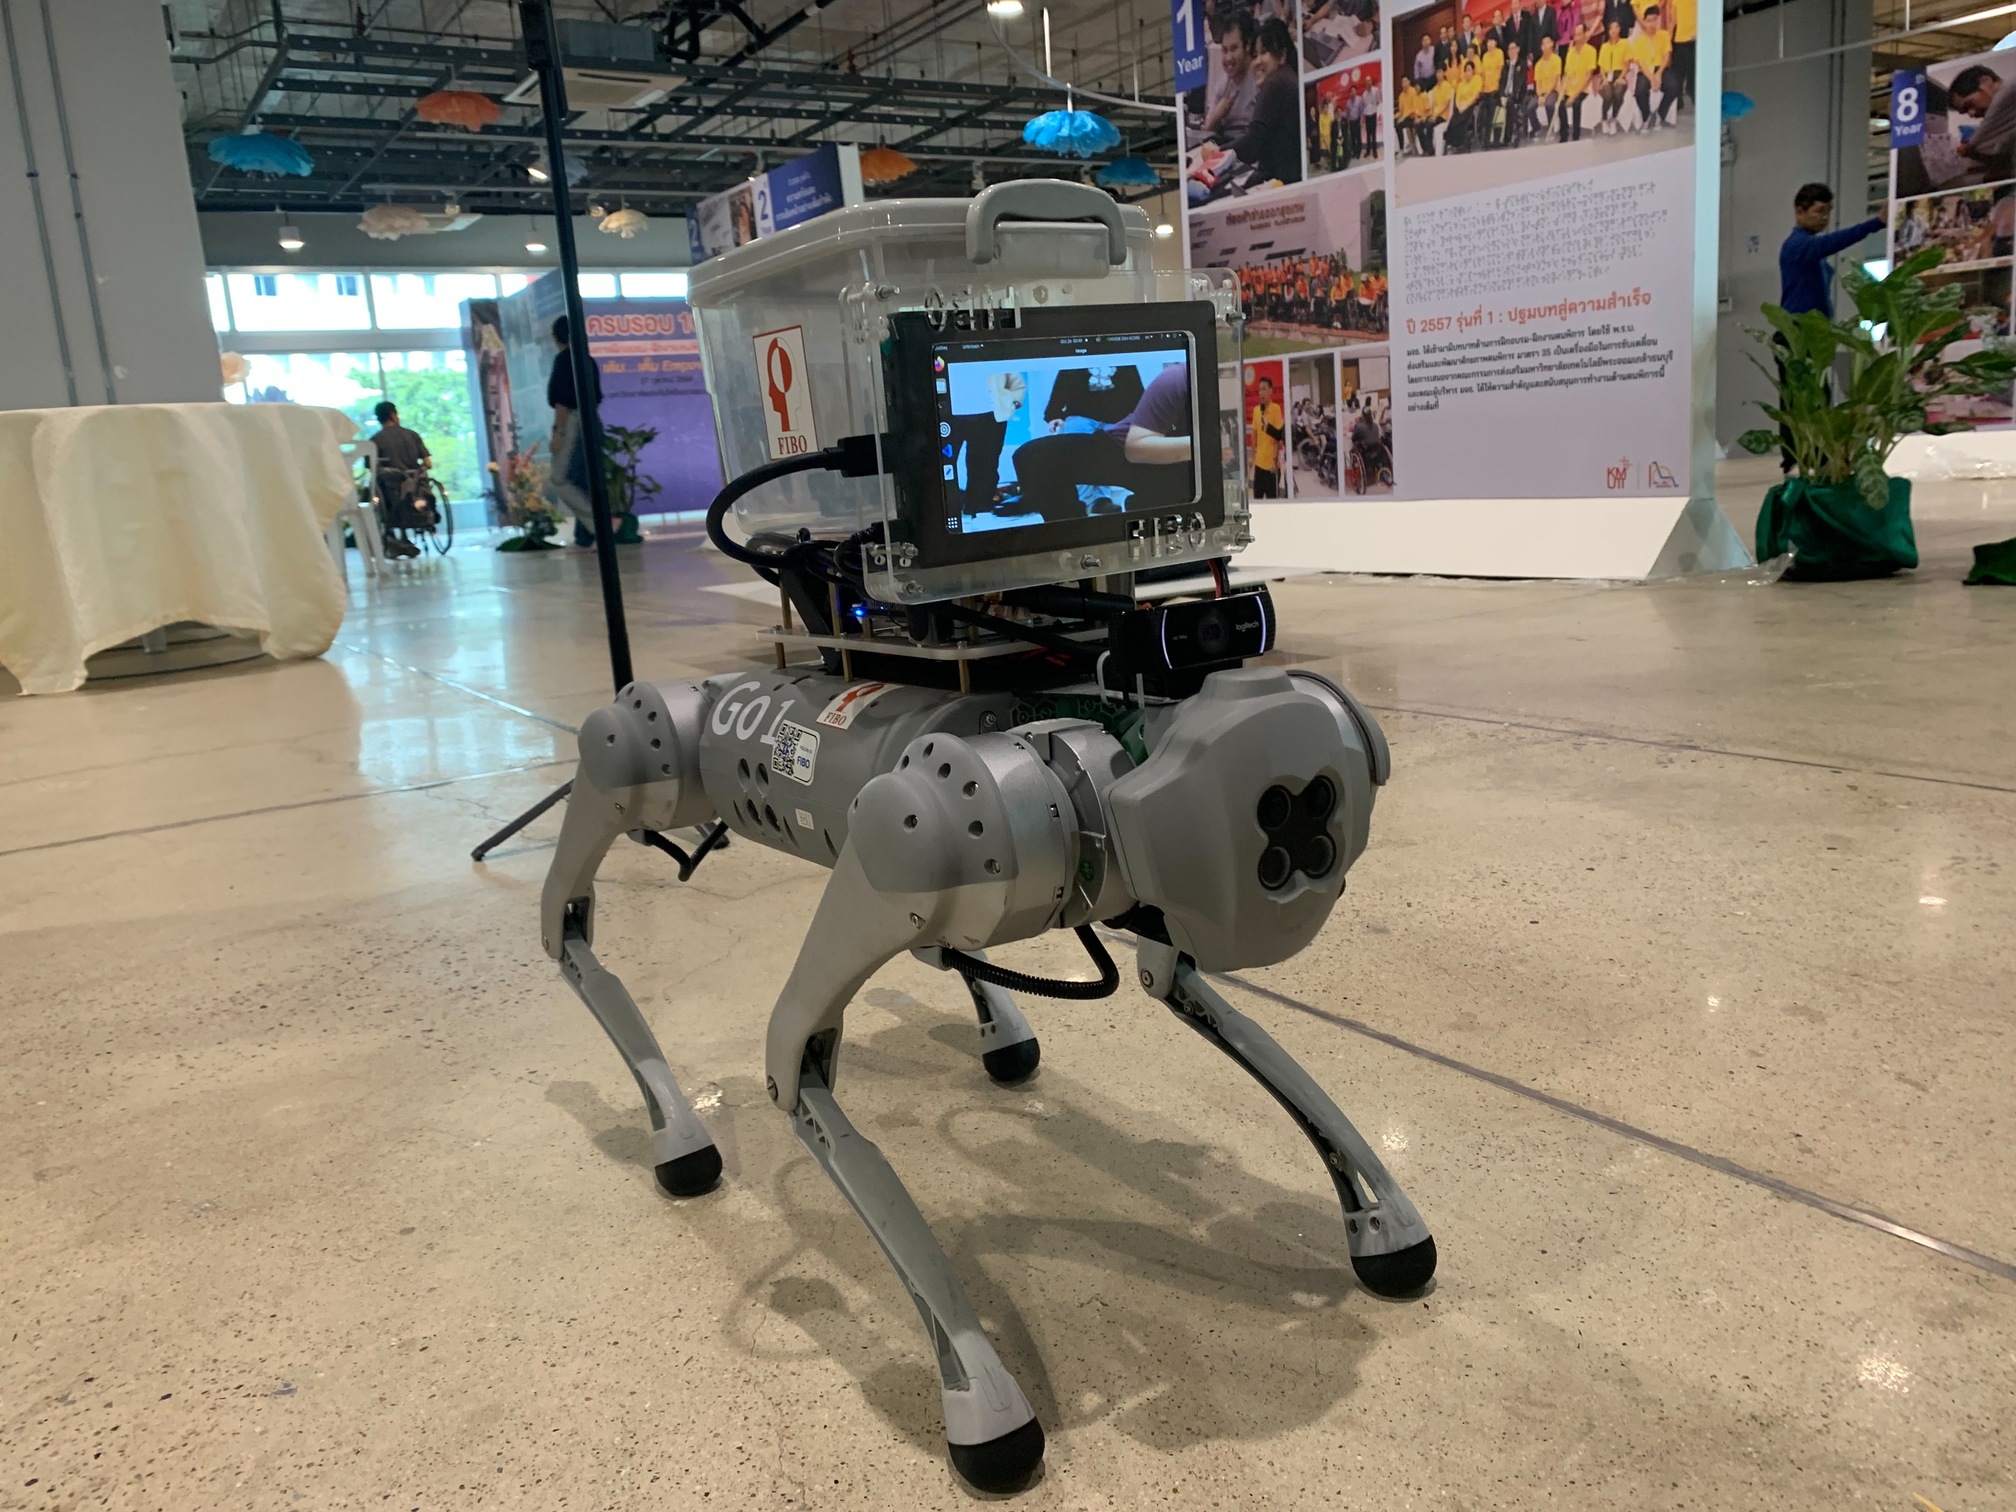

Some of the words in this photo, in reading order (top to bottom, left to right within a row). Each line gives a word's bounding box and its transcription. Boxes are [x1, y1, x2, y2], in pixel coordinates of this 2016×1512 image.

[1176, 0, 1195, 51] 1
[1177, 55, 1204, 75] Year
[1897, 87, 1919, 122] 8
[1895, 123, 1922, 136] Year
[758, 189, 769, 221] 2
[690, 218, 699, 247] 2
[586, 313, 674, 336] ครบรอบ
[1406, 316, 1416, 334] ปี
[1420, 316, 1452, 333] 2557
[1456, 304, 1482, 333] รุ่นที่
[1487, 311, 1493, 324] 1
[1542, 348, 1551, 357] 35
[778, 435, 807, 455] FIBO
[1236, 621, 1260, 632] logitech
[823, 711, 848, 726] FIBO
[797, 755, 810, 769] FIBO
